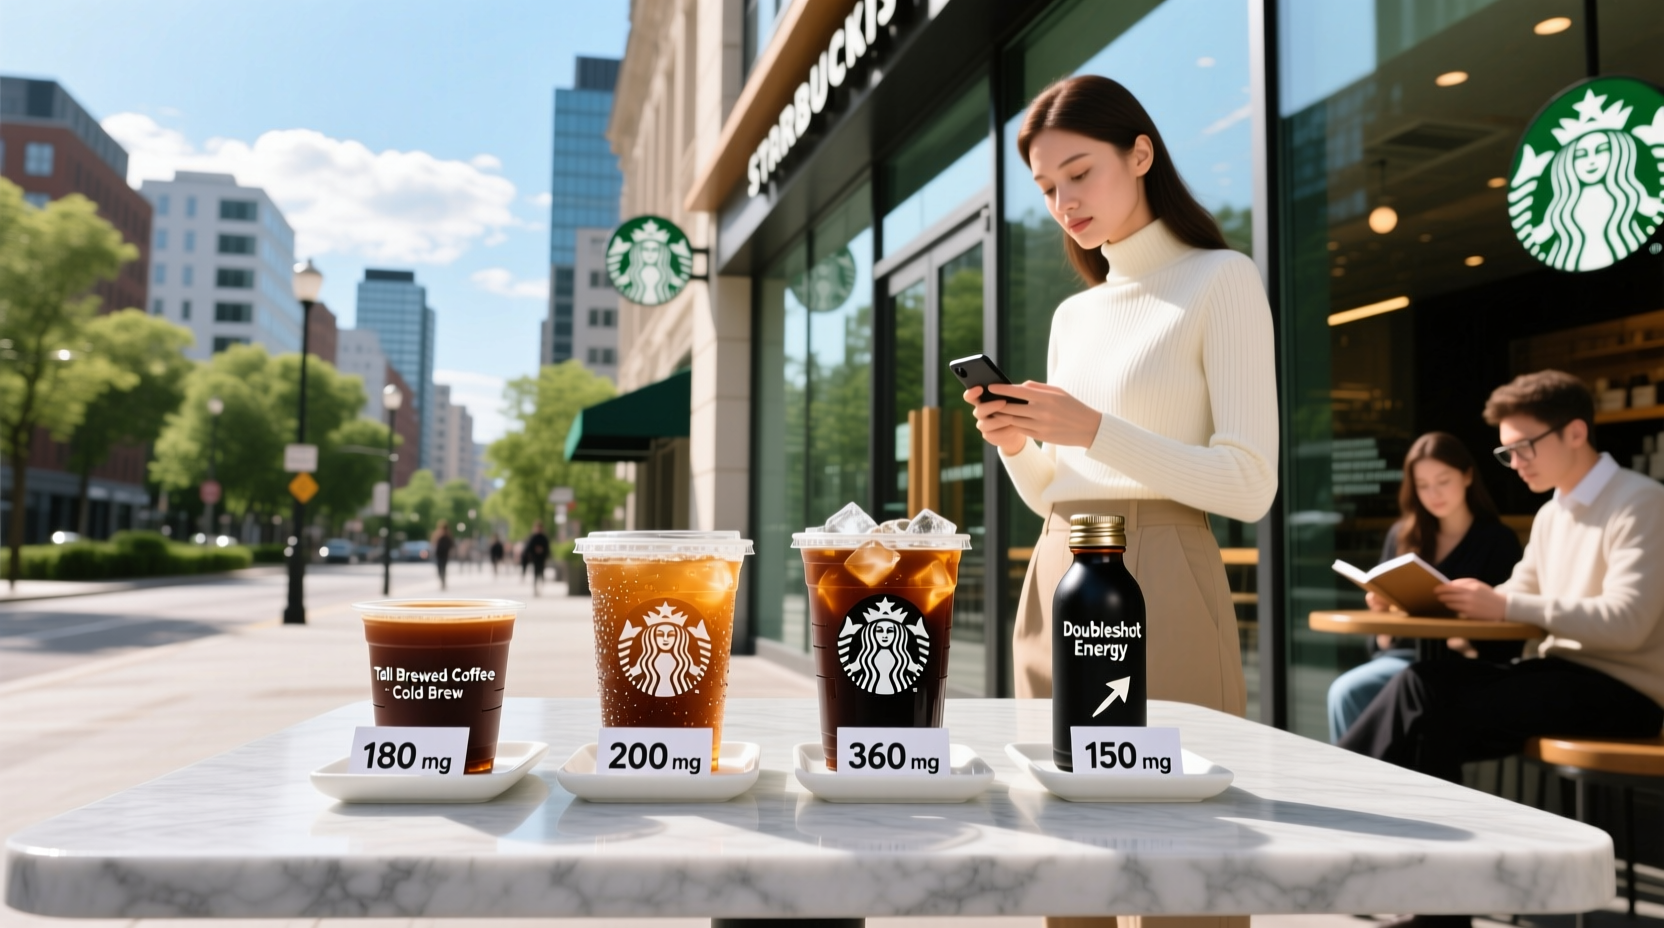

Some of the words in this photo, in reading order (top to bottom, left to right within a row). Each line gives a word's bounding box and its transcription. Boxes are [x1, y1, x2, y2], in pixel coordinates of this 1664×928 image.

[1063, 620, 1142, 639] Doubleshot
[1074, 640, 1128, 662] Energy
[396, 667, 448, 683] Brewed
[451, 666, 496, 682] Coffee
[392, 684, 424, 700] Cold
[428, 685, 464, 700] Brew
[363, 741, 417, 770] 180
[421, 756, 452, 774] mg
[608, 741, 668, 770] 200
[672, 757, 701, 775] mg
[848, 742, 906, 770] 360
[911, 757, 940, 775] mg
[1085, 741, 1137, 769] 150
[1142, 756, 1172, 774] mg
